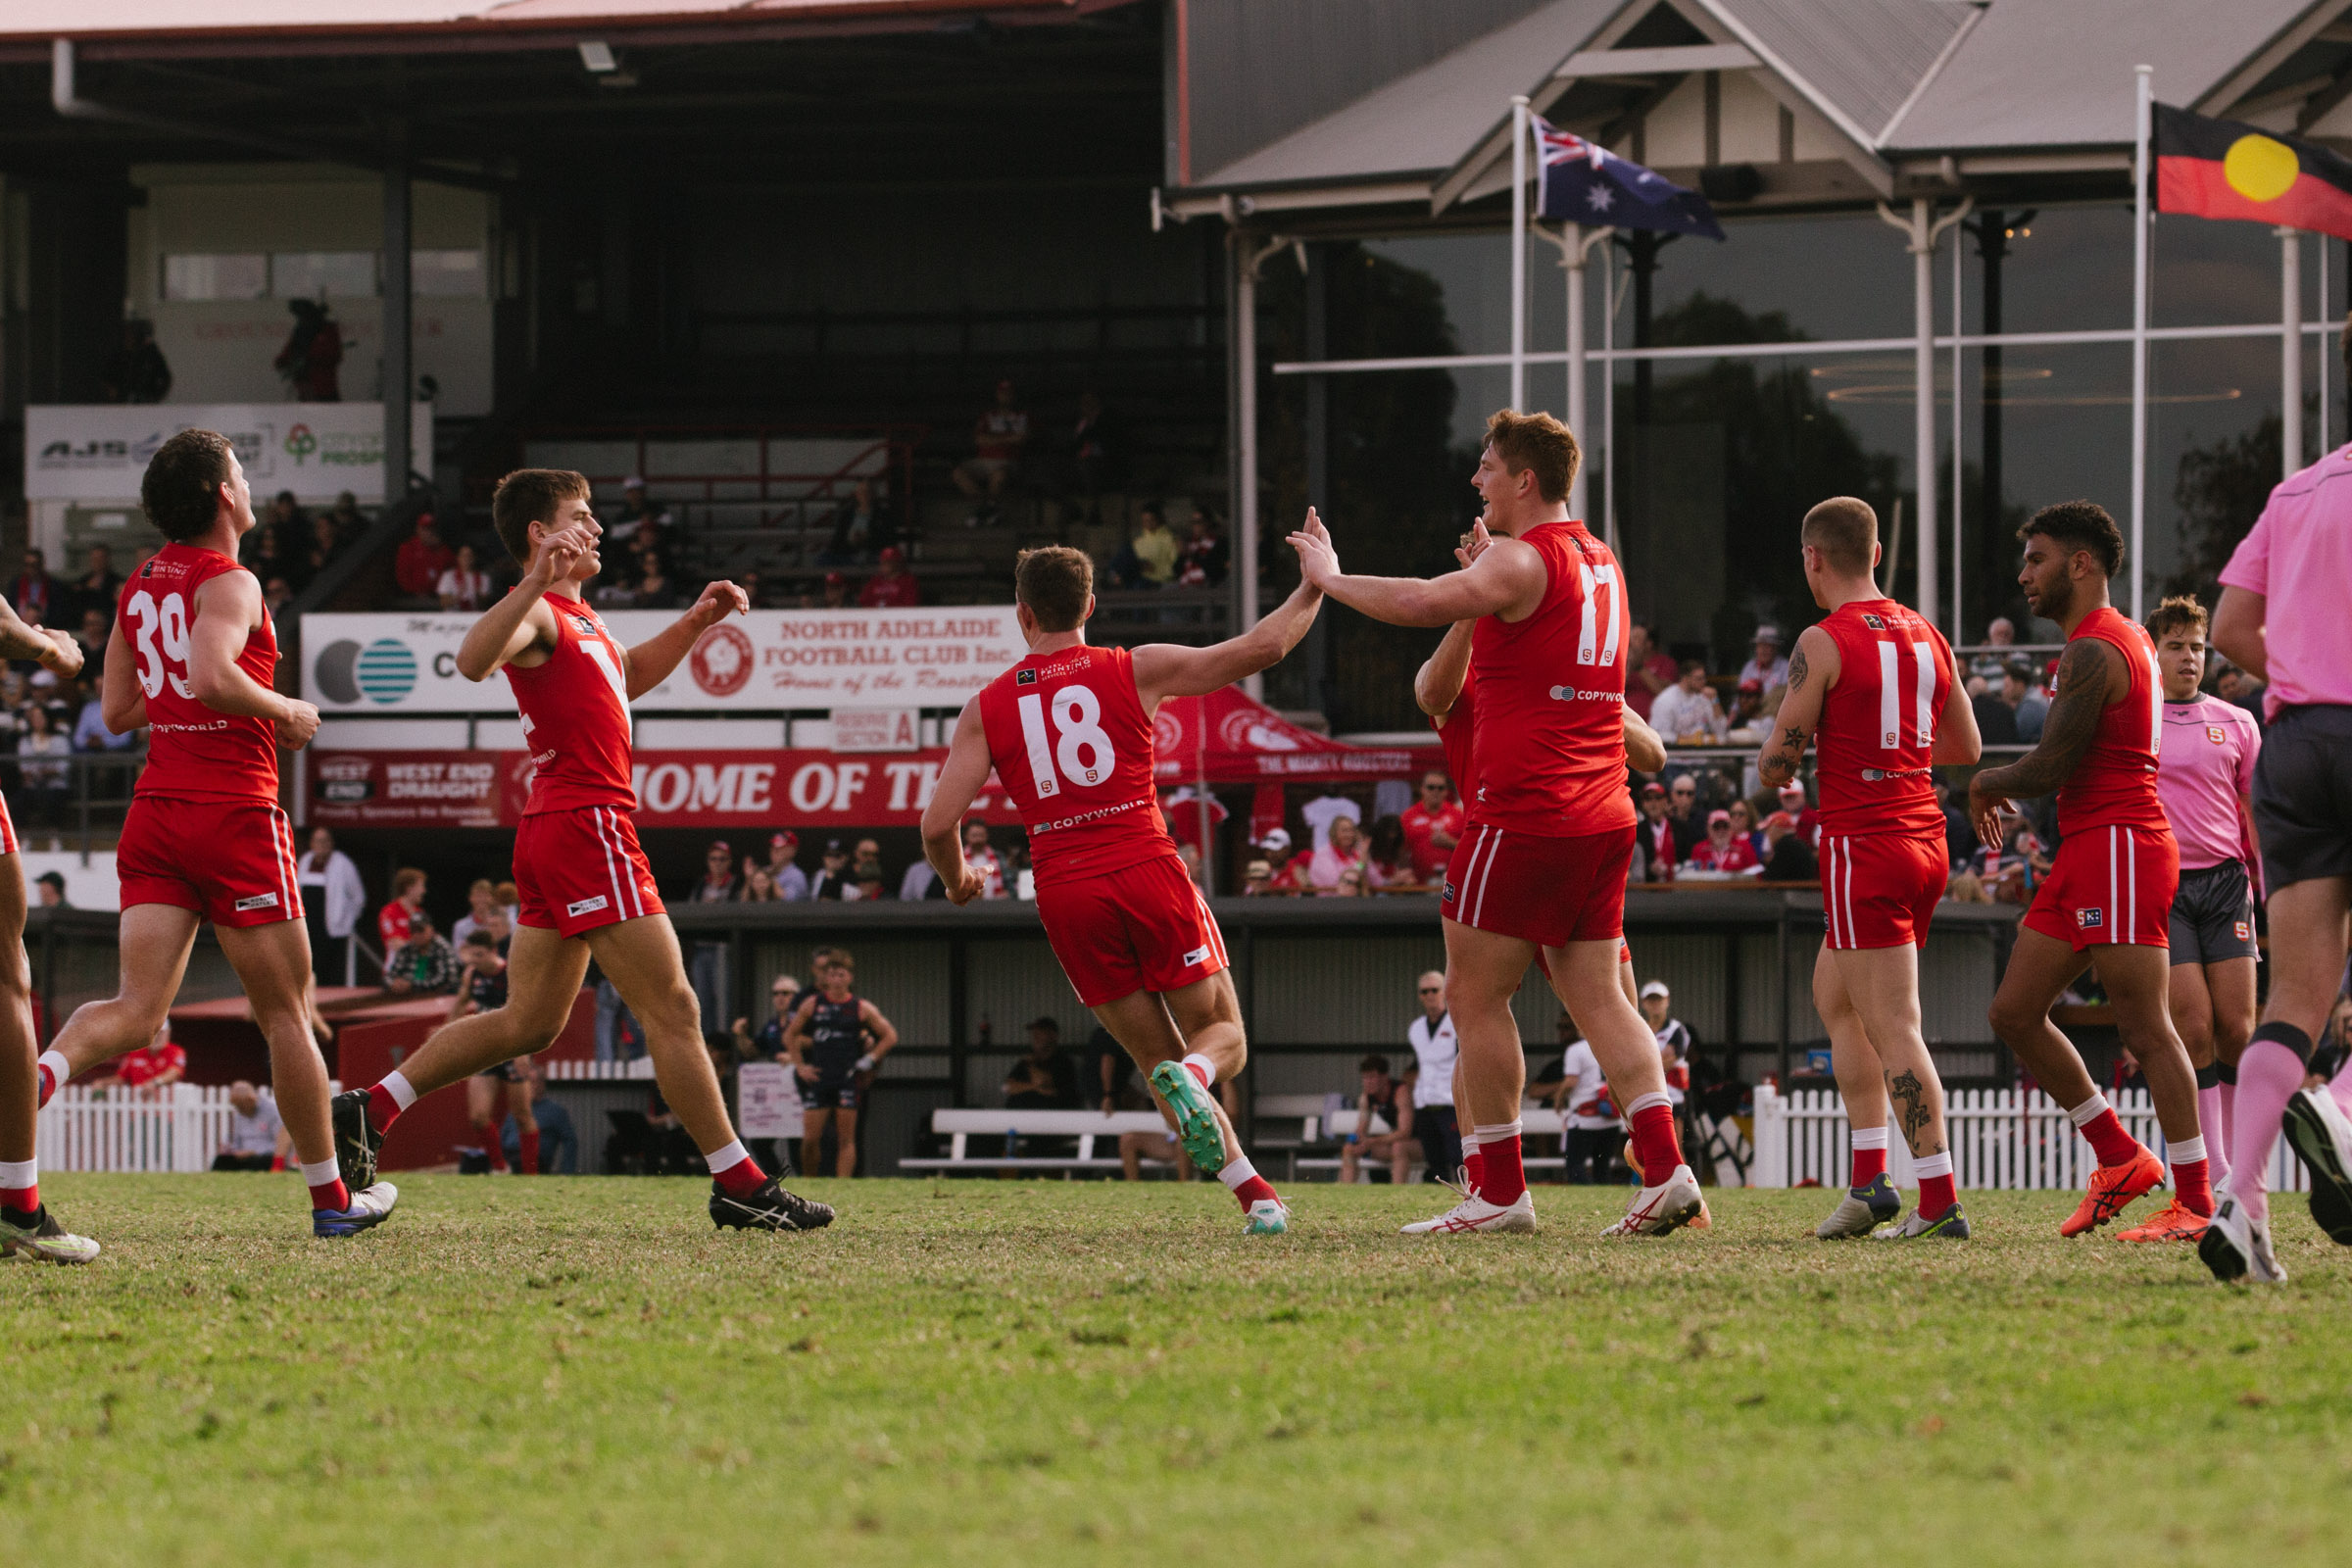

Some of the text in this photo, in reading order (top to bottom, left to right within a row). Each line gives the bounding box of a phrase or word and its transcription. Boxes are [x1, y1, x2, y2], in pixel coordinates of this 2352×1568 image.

[41, 440, 127, 457] AJS
[1577, 564, 1620, 666] 17
[780, 618, 1002, 640] NORTH ADELAIDE
[126, 590, 196, 700] 39
[763, 645, 1017, 666] FOOTBALL CLUB Inc.
[1041, 659, 1091, 676] PRINTING
[1577, 690, 1624, 703] COPYWO
[1877, 641, 1936, 750] 11
[896, 711, 913, 744] A
[1017, 684, 1116, 800] 18
[386, 762, 494, 780] WEST END
[387, 781, 492, 800] DRAUGHT
[789, 760, 870, 813] OF
[1053, 799, 1146, 830] COPYWORLD
